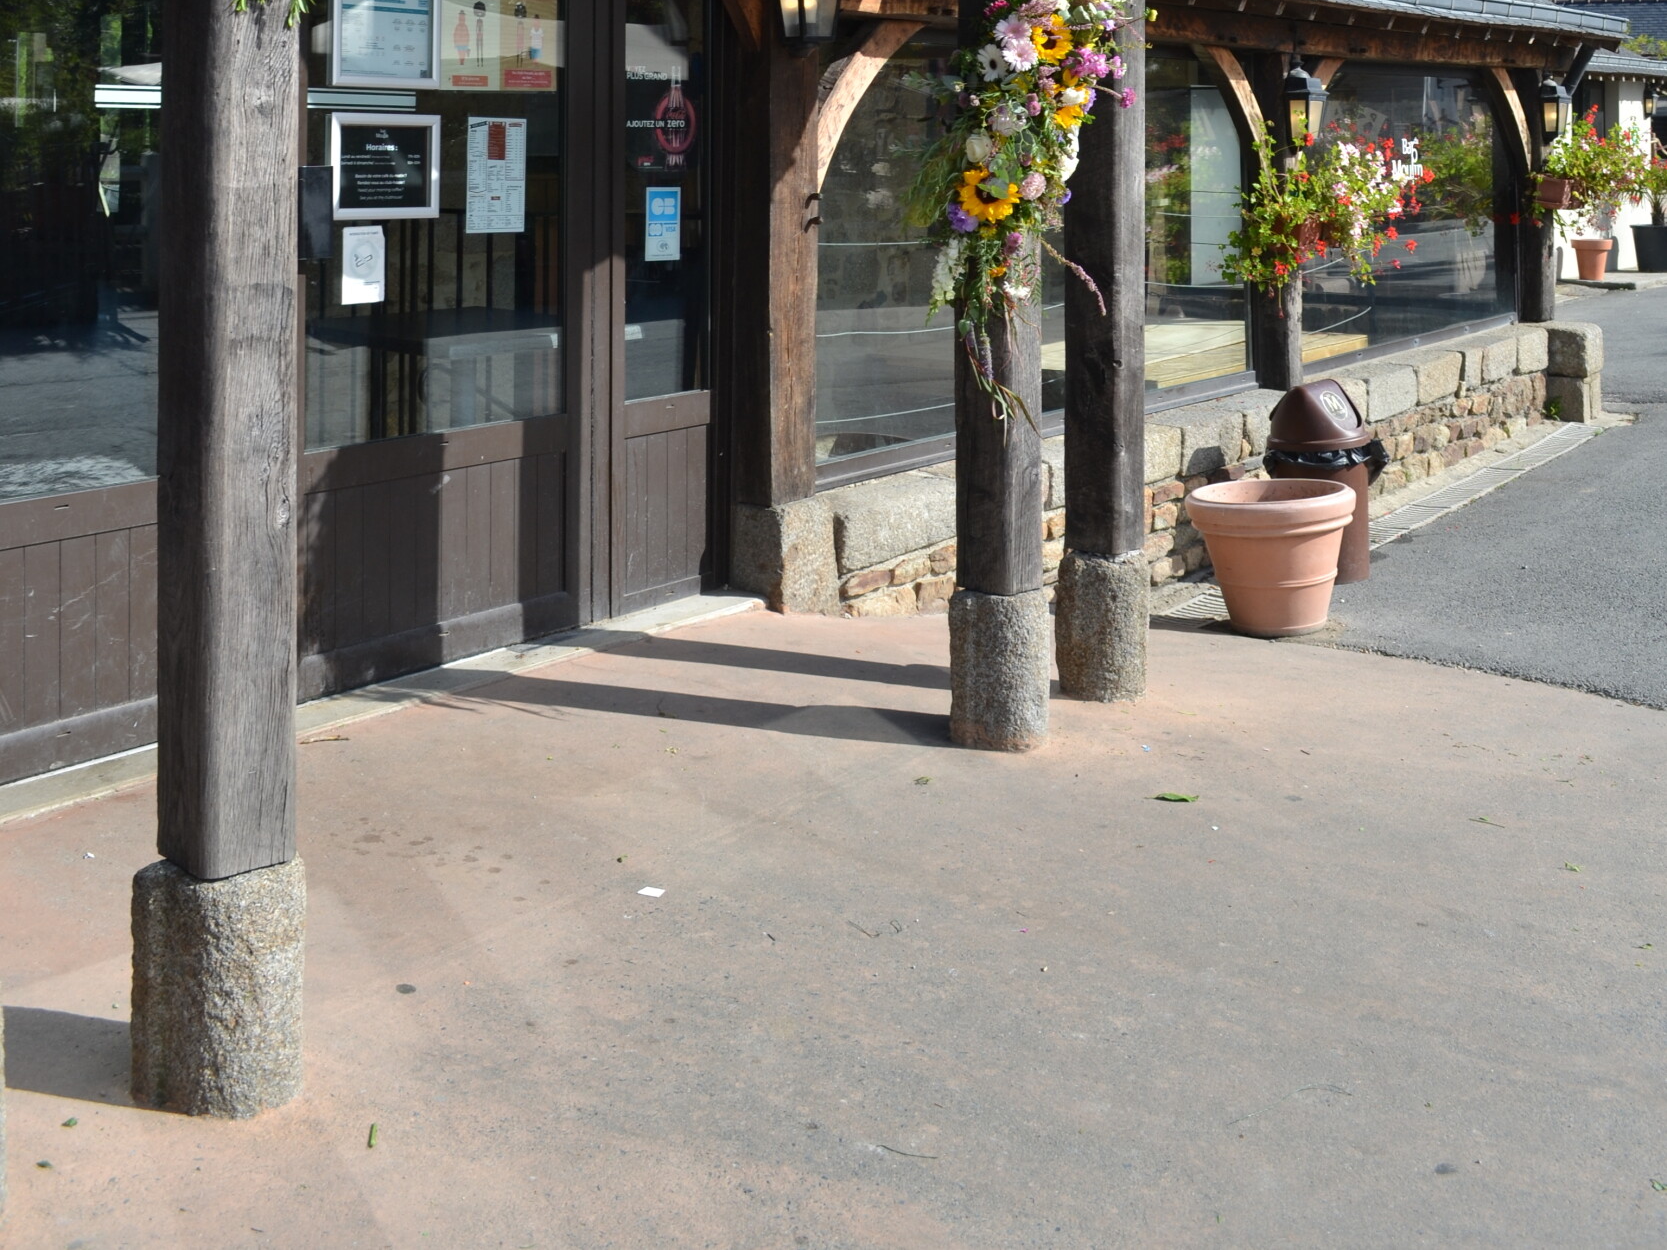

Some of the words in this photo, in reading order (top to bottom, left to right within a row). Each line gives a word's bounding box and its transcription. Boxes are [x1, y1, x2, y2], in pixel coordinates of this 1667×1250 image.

[626, 72, 643, 80] PLUS
[644, 72, 668, 81] GRAND
[626, 120, 655, 128] AJOUTEZ
[656, 120, 665, 128] UN
[667, 119, 685, 128] zero
[651, 197, 675, 216] CB
